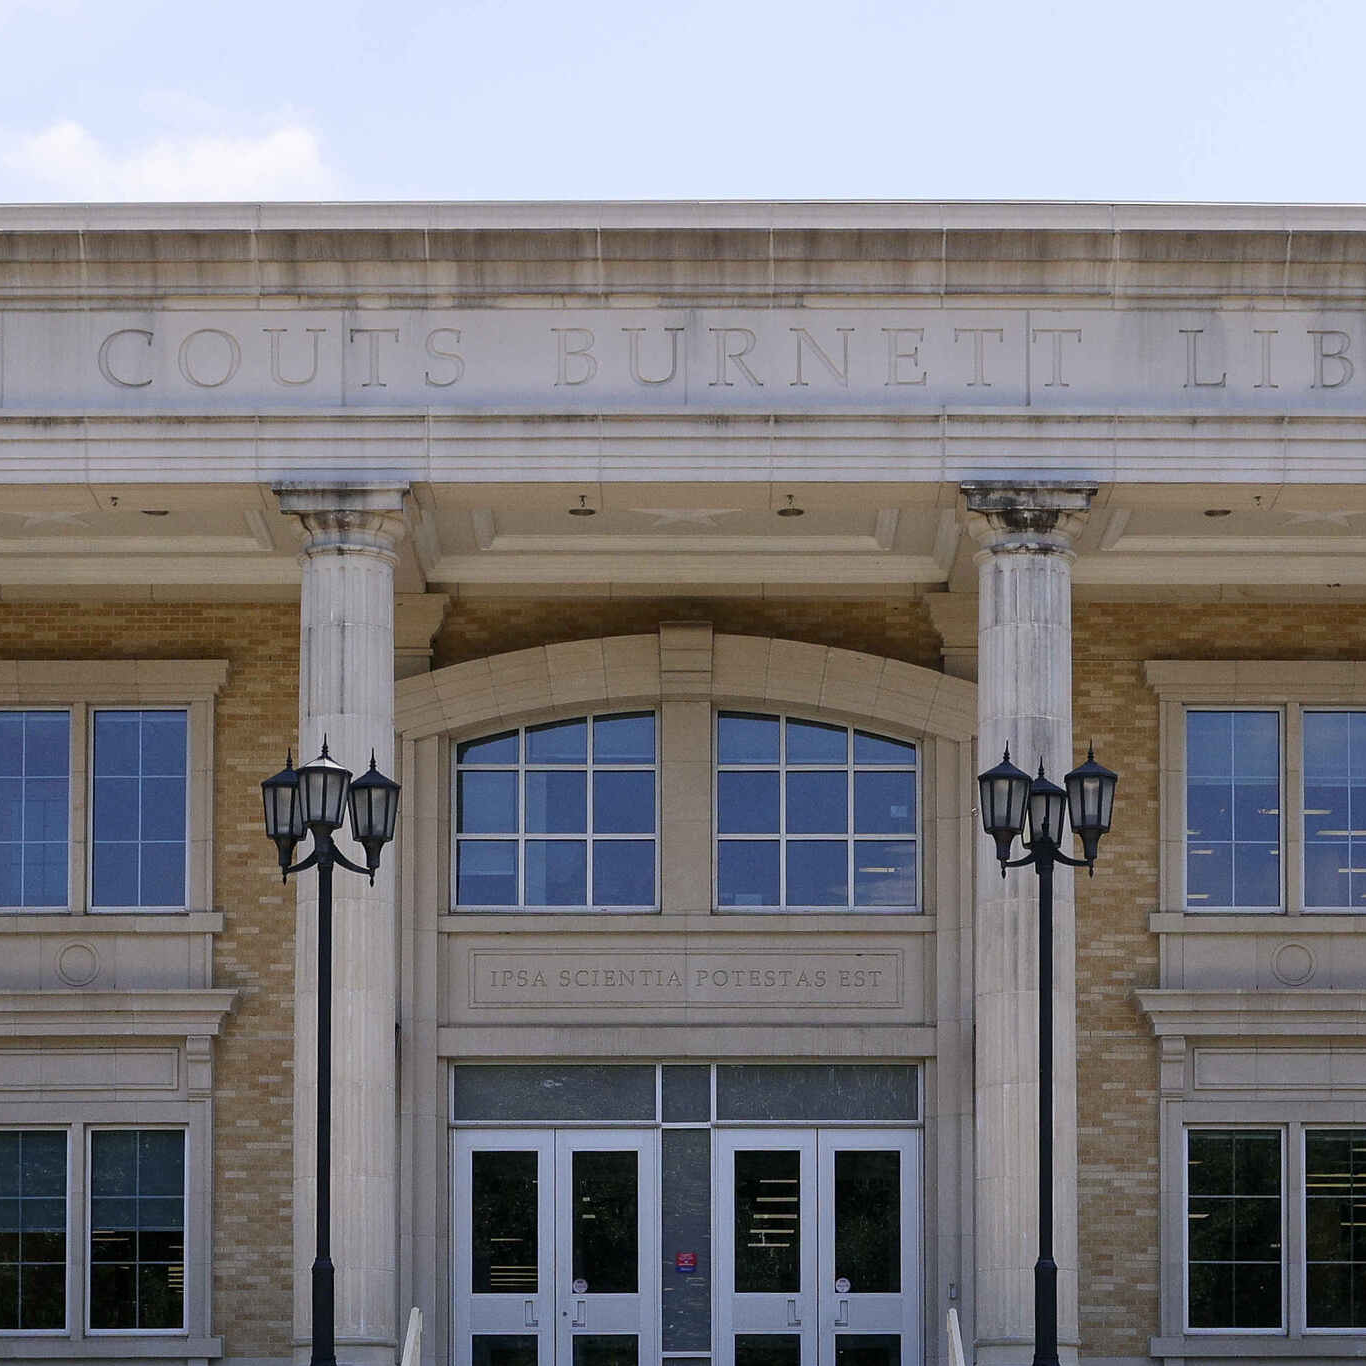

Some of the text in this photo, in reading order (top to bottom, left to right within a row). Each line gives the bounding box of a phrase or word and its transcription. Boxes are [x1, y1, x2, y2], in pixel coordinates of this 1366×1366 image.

[98, 327, 466, 389] COUTS
[550, 327, 1082, 388] BURNETT
[490, 969, 884, 988] IPSA SCIENTIA POTESTAS EST
